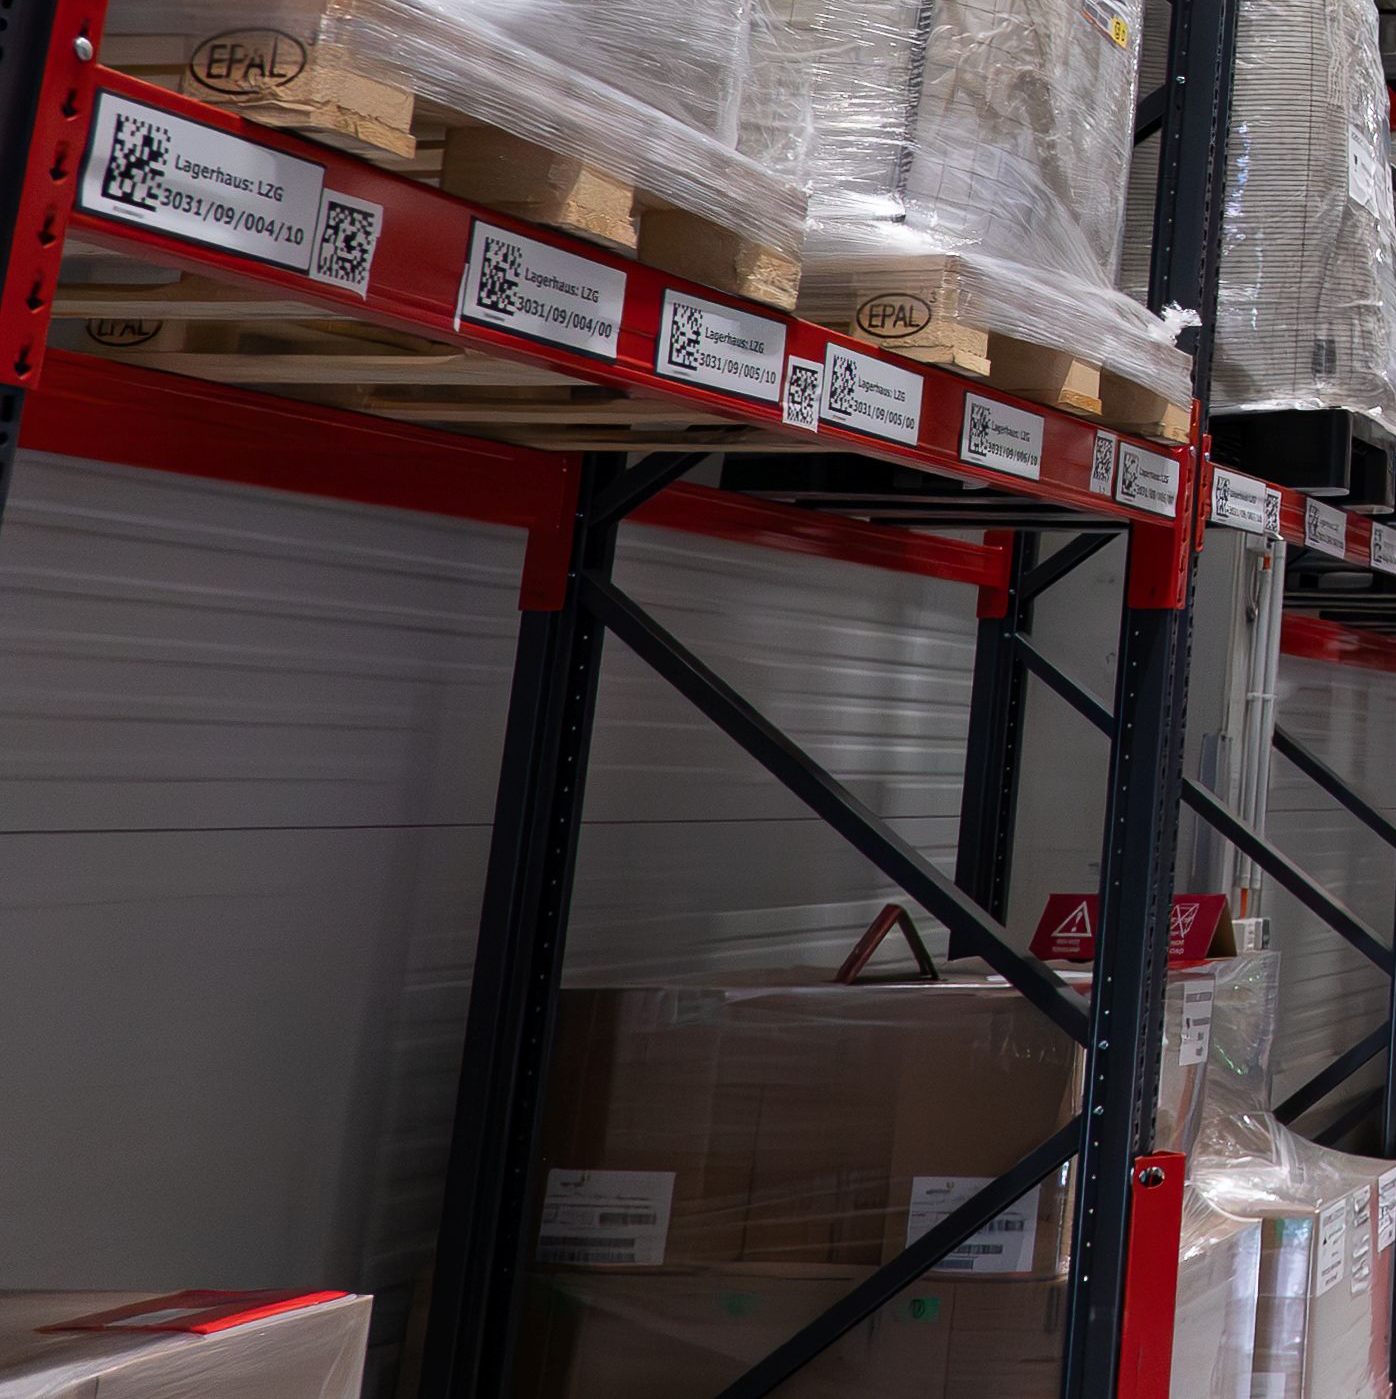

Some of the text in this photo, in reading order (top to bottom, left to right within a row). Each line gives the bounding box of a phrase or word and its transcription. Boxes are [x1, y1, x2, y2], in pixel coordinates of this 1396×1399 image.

[206, 36, 287, 79] EPAL
[174, 154, 284, 202] Lagerhaus: LZG
[162, 189, 304, 245] 3031/09/004/10
[524, 267, 599, 303] Lagerhaus: LZG
[516, 296, 612, 338] 3031/09/004/00
[868, 304, 921, 328] EPAL
[705, 327, 764, 354] Lagerhaus: LZG
[699, 352, 776, 384] 3031/09/005/10
